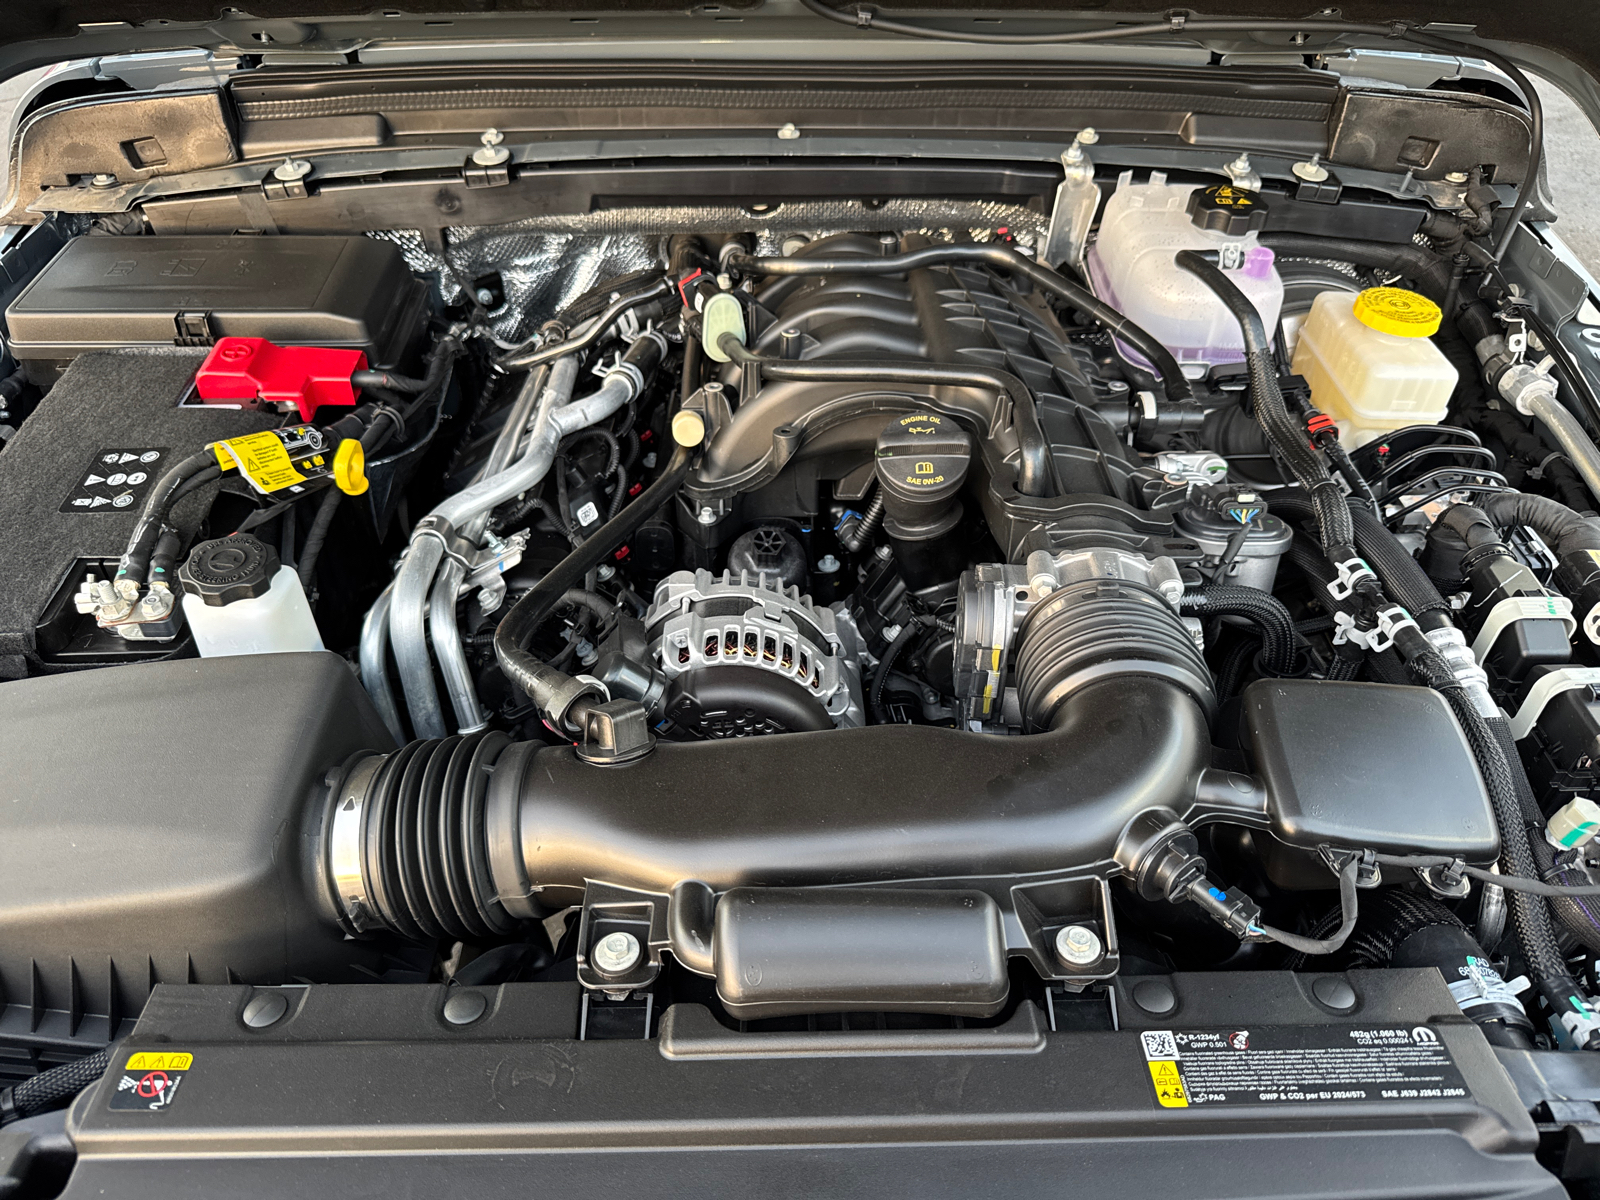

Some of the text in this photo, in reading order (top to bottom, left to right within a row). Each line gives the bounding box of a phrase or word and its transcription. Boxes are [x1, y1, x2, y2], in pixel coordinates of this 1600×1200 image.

[900, 415, 941, 426] ENGINE OIL
[906, 475, 944, 485] SAE 0W-20
[225, 537, 263, 554] APPROVED
[200, 573, 240, 584] STEERING
[1188, 1033, 1220, 1041] R-1234yf
[1349, 1030, 1370, 1039] 482g
[1190, 1041, 1208, 1049] GWP
[1208, 1093, 1226, 1101] PAG
[1287, 1092, 1304, 1100] CO2
[1305, 1092, 1318, 1101] per
[1319, 1091, 1331, 1099] EU
[1332, 1090, 1366, 1099] 2024/573
[1381, 1089, 1399, 1098] SAE
